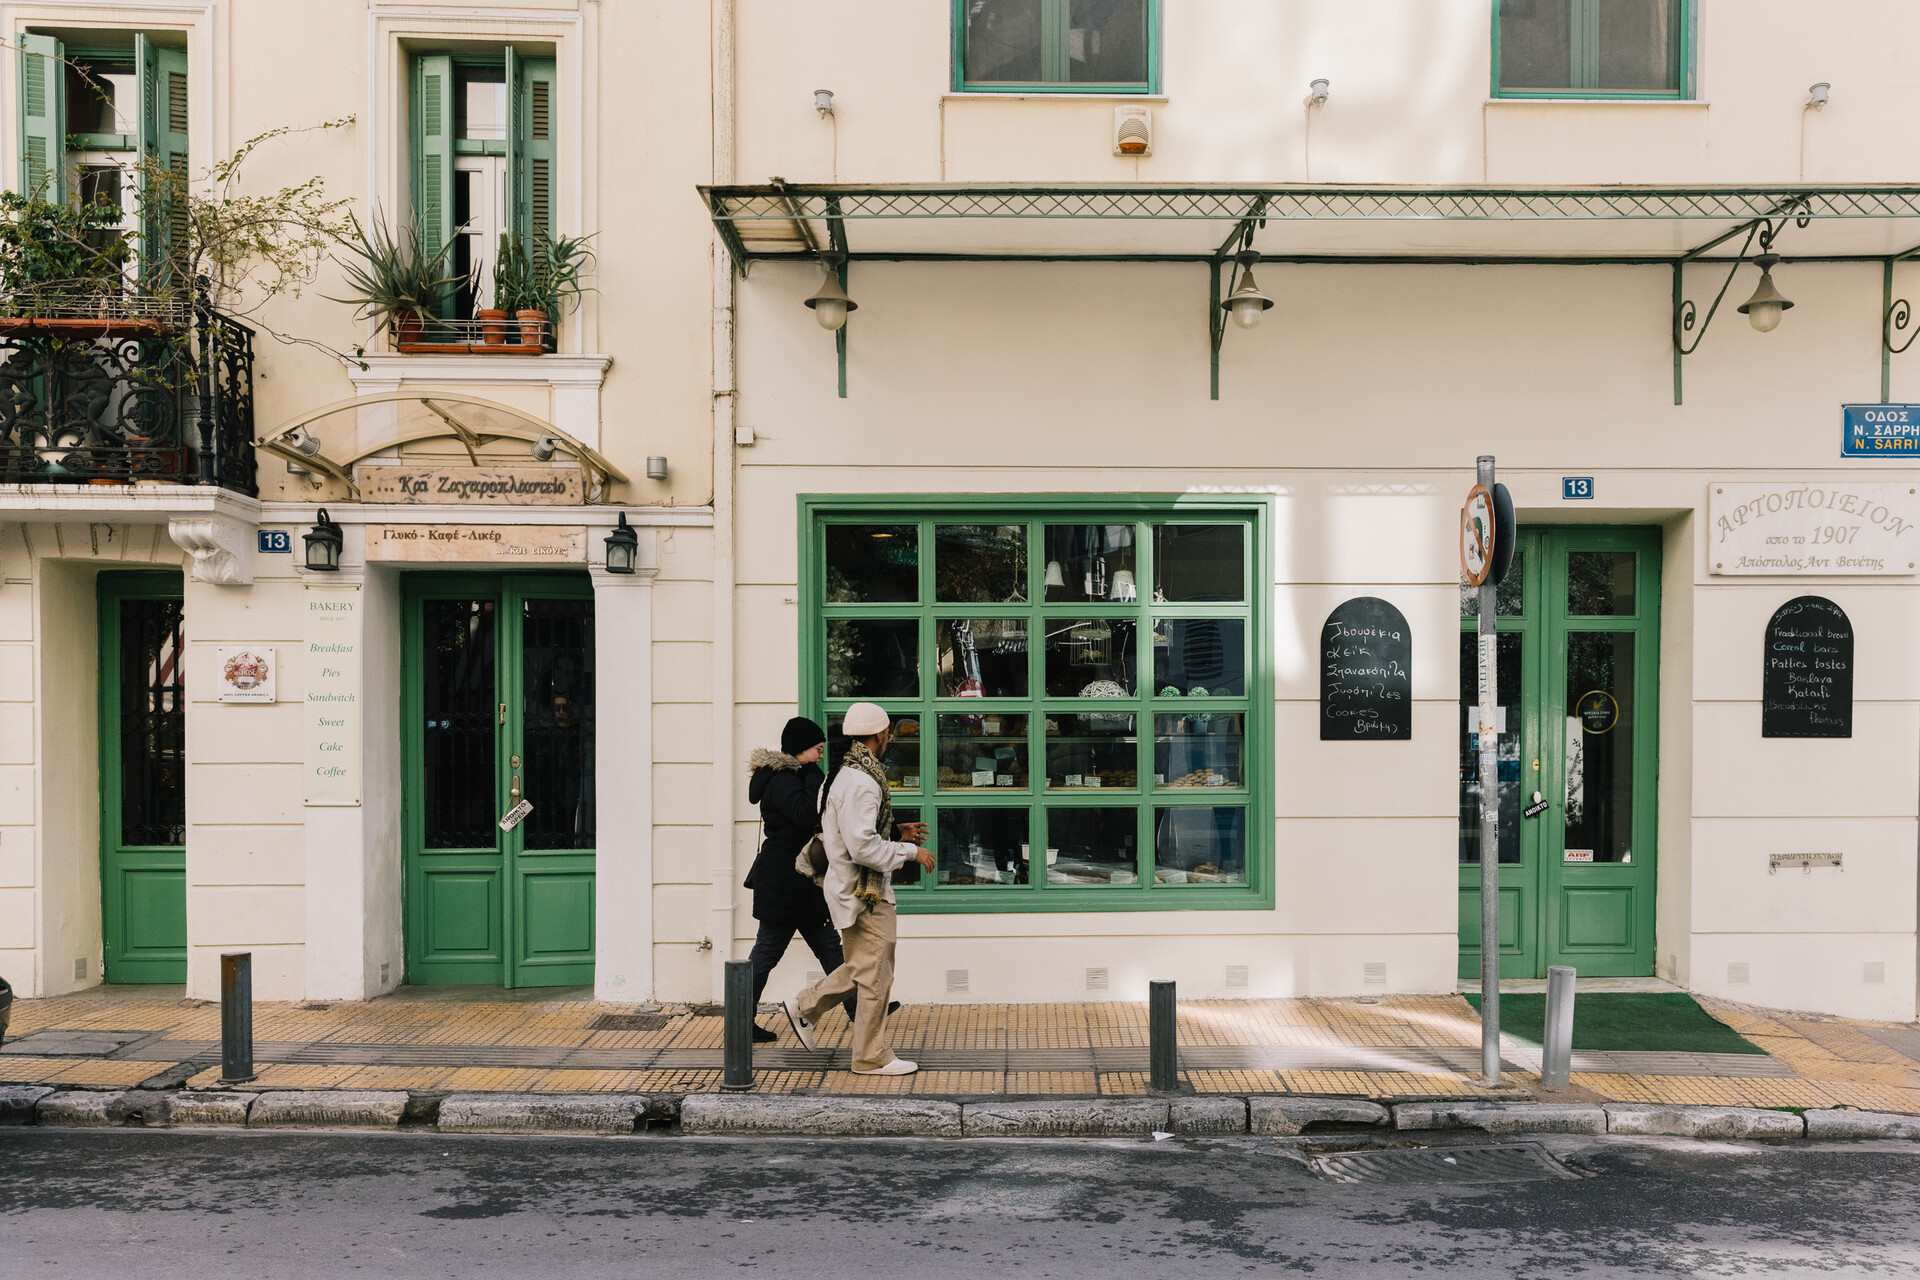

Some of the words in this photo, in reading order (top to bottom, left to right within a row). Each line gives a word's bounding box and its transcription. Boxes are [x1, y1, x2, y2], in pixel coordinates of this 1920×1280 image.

[1865, 411, 1908, 422] ΟΔΟΣ
[1854, 425, 1868, 436] Ν.
[1874, 425, 1920, 436] ΣΑΡΡΗ
[1855, 439, 1870, 450] N.
[1874, 438, 1918, 450] SARRI
[1568, 480, 1588, 495] 13
[1717, 487, 1914, 543] ΑΡΤΟΠΟΙΕΙΟΝ
[383, 529, 418, 540] Γλυκό
[428, 529, 459, 542] Καφέ
[468, 529, 501, 542] Λικέρ
[1811, 526, 1861, 544] 1907
[265, 533, 285, 549] 13
[1735, 555, 1803, 570] Απόστολος
[310, 602, 355, 611] BAKERY
[310, 643, 353, 654] Breakfast
[1773, 641, 1805, 653] Cereal
[1813, 643, 1839, 653] bars
[322, 668, 341, 677] Pies
[307, 693, 355, 702] Sandwitch
[318, 718, 344, 727] Sweet
[319, 742, 343, 751] Cake
[316, 767, 346, 778] Coffee
